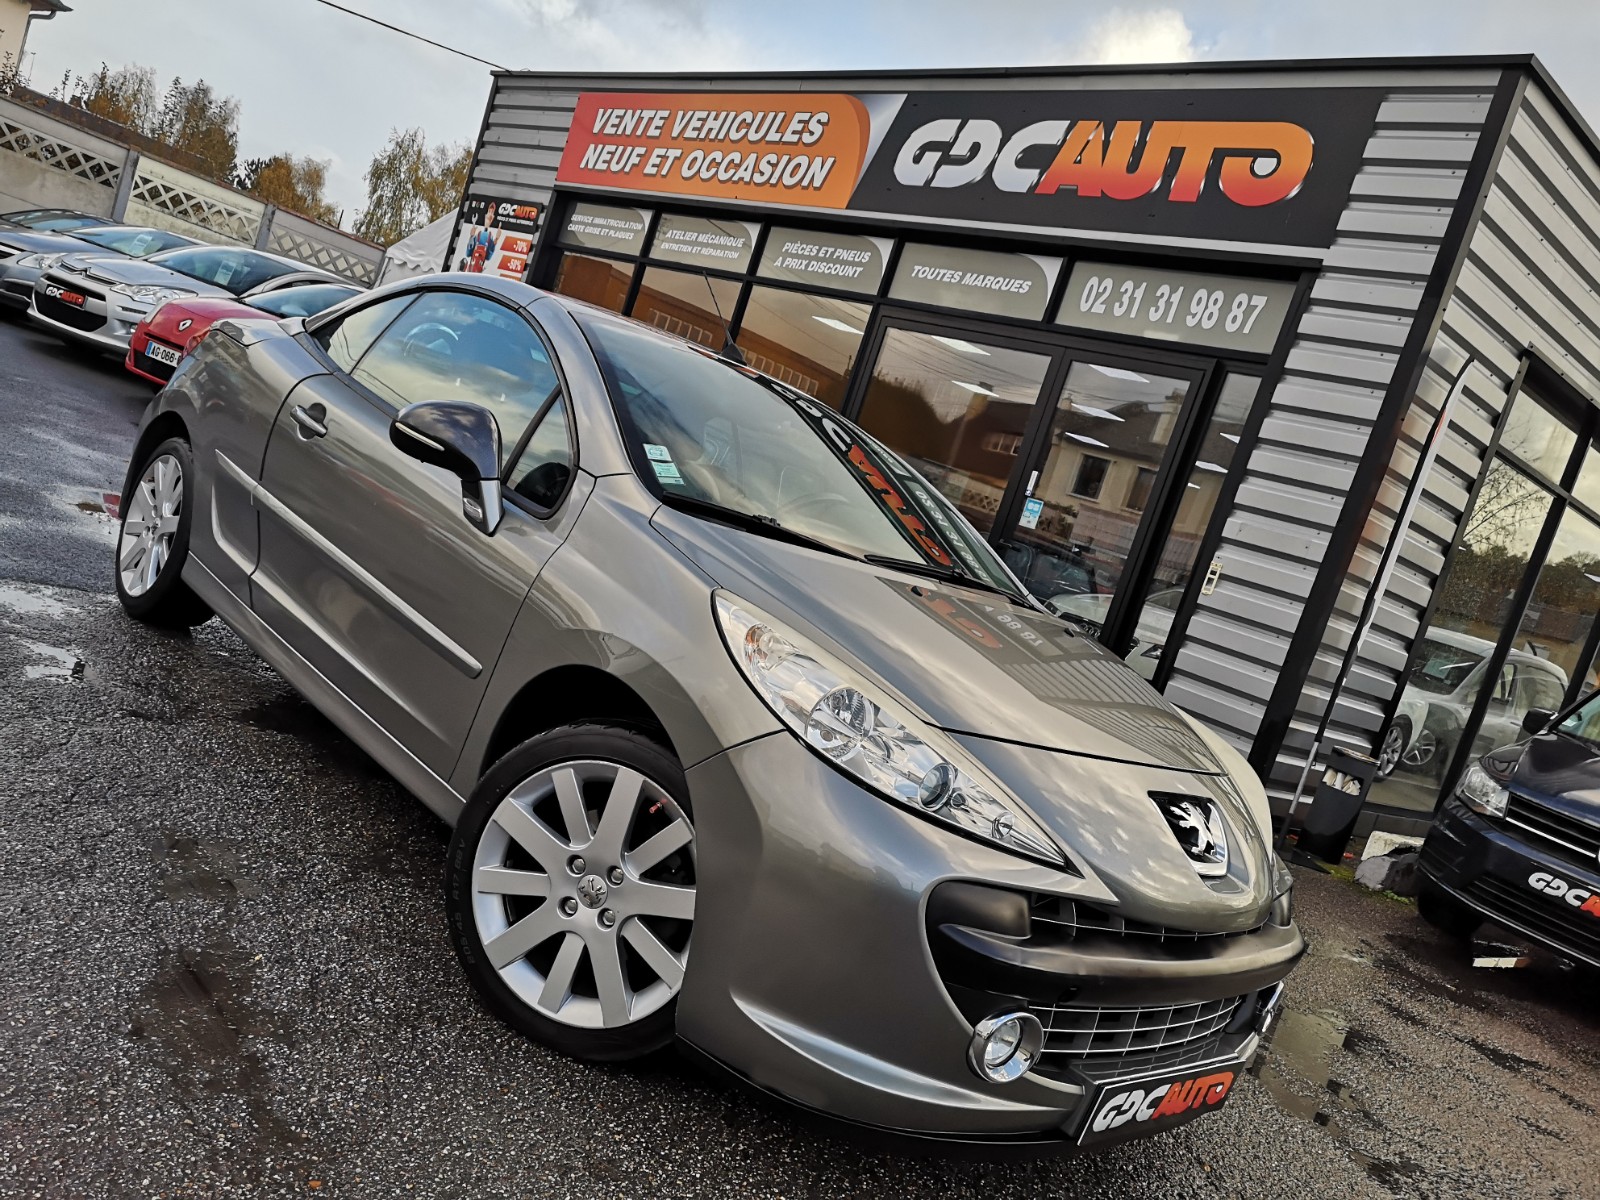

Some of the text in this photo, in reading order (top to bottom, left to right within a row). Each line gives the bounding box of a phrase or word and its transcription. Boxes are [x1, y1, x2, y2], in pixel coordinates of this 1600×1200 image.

[592, 108, 829, 145] VENTE VEHICULES
[579, 144, 835, 189] NEUF ET OCCASION
[893, 118, 1314, 206] GDCAUTO
[567, 223, 634, 240] CARTE GRISE ET PLAQUES
[571, 214, 643, 230] SERVICE IMMATRICULATION
[661, 242, 739, 259] ENTRETIEN ET RÉPARATION
[665, 229, 745, 247] ATELIER MÉCANIQUE
[782, 240, 871, 263] PIÈCES ET PNEUS
[773, 256, 864, 278] A PRIX DISCOUNT
[911, 265, 1032, 293] TOUTES MARQUES
[1080, 276, 1268, 334] 02 31 31 98 87
[1528, 872, 1600, 917] GDCA
[1092, 1071, 1234, 1132] GDCAUTO
